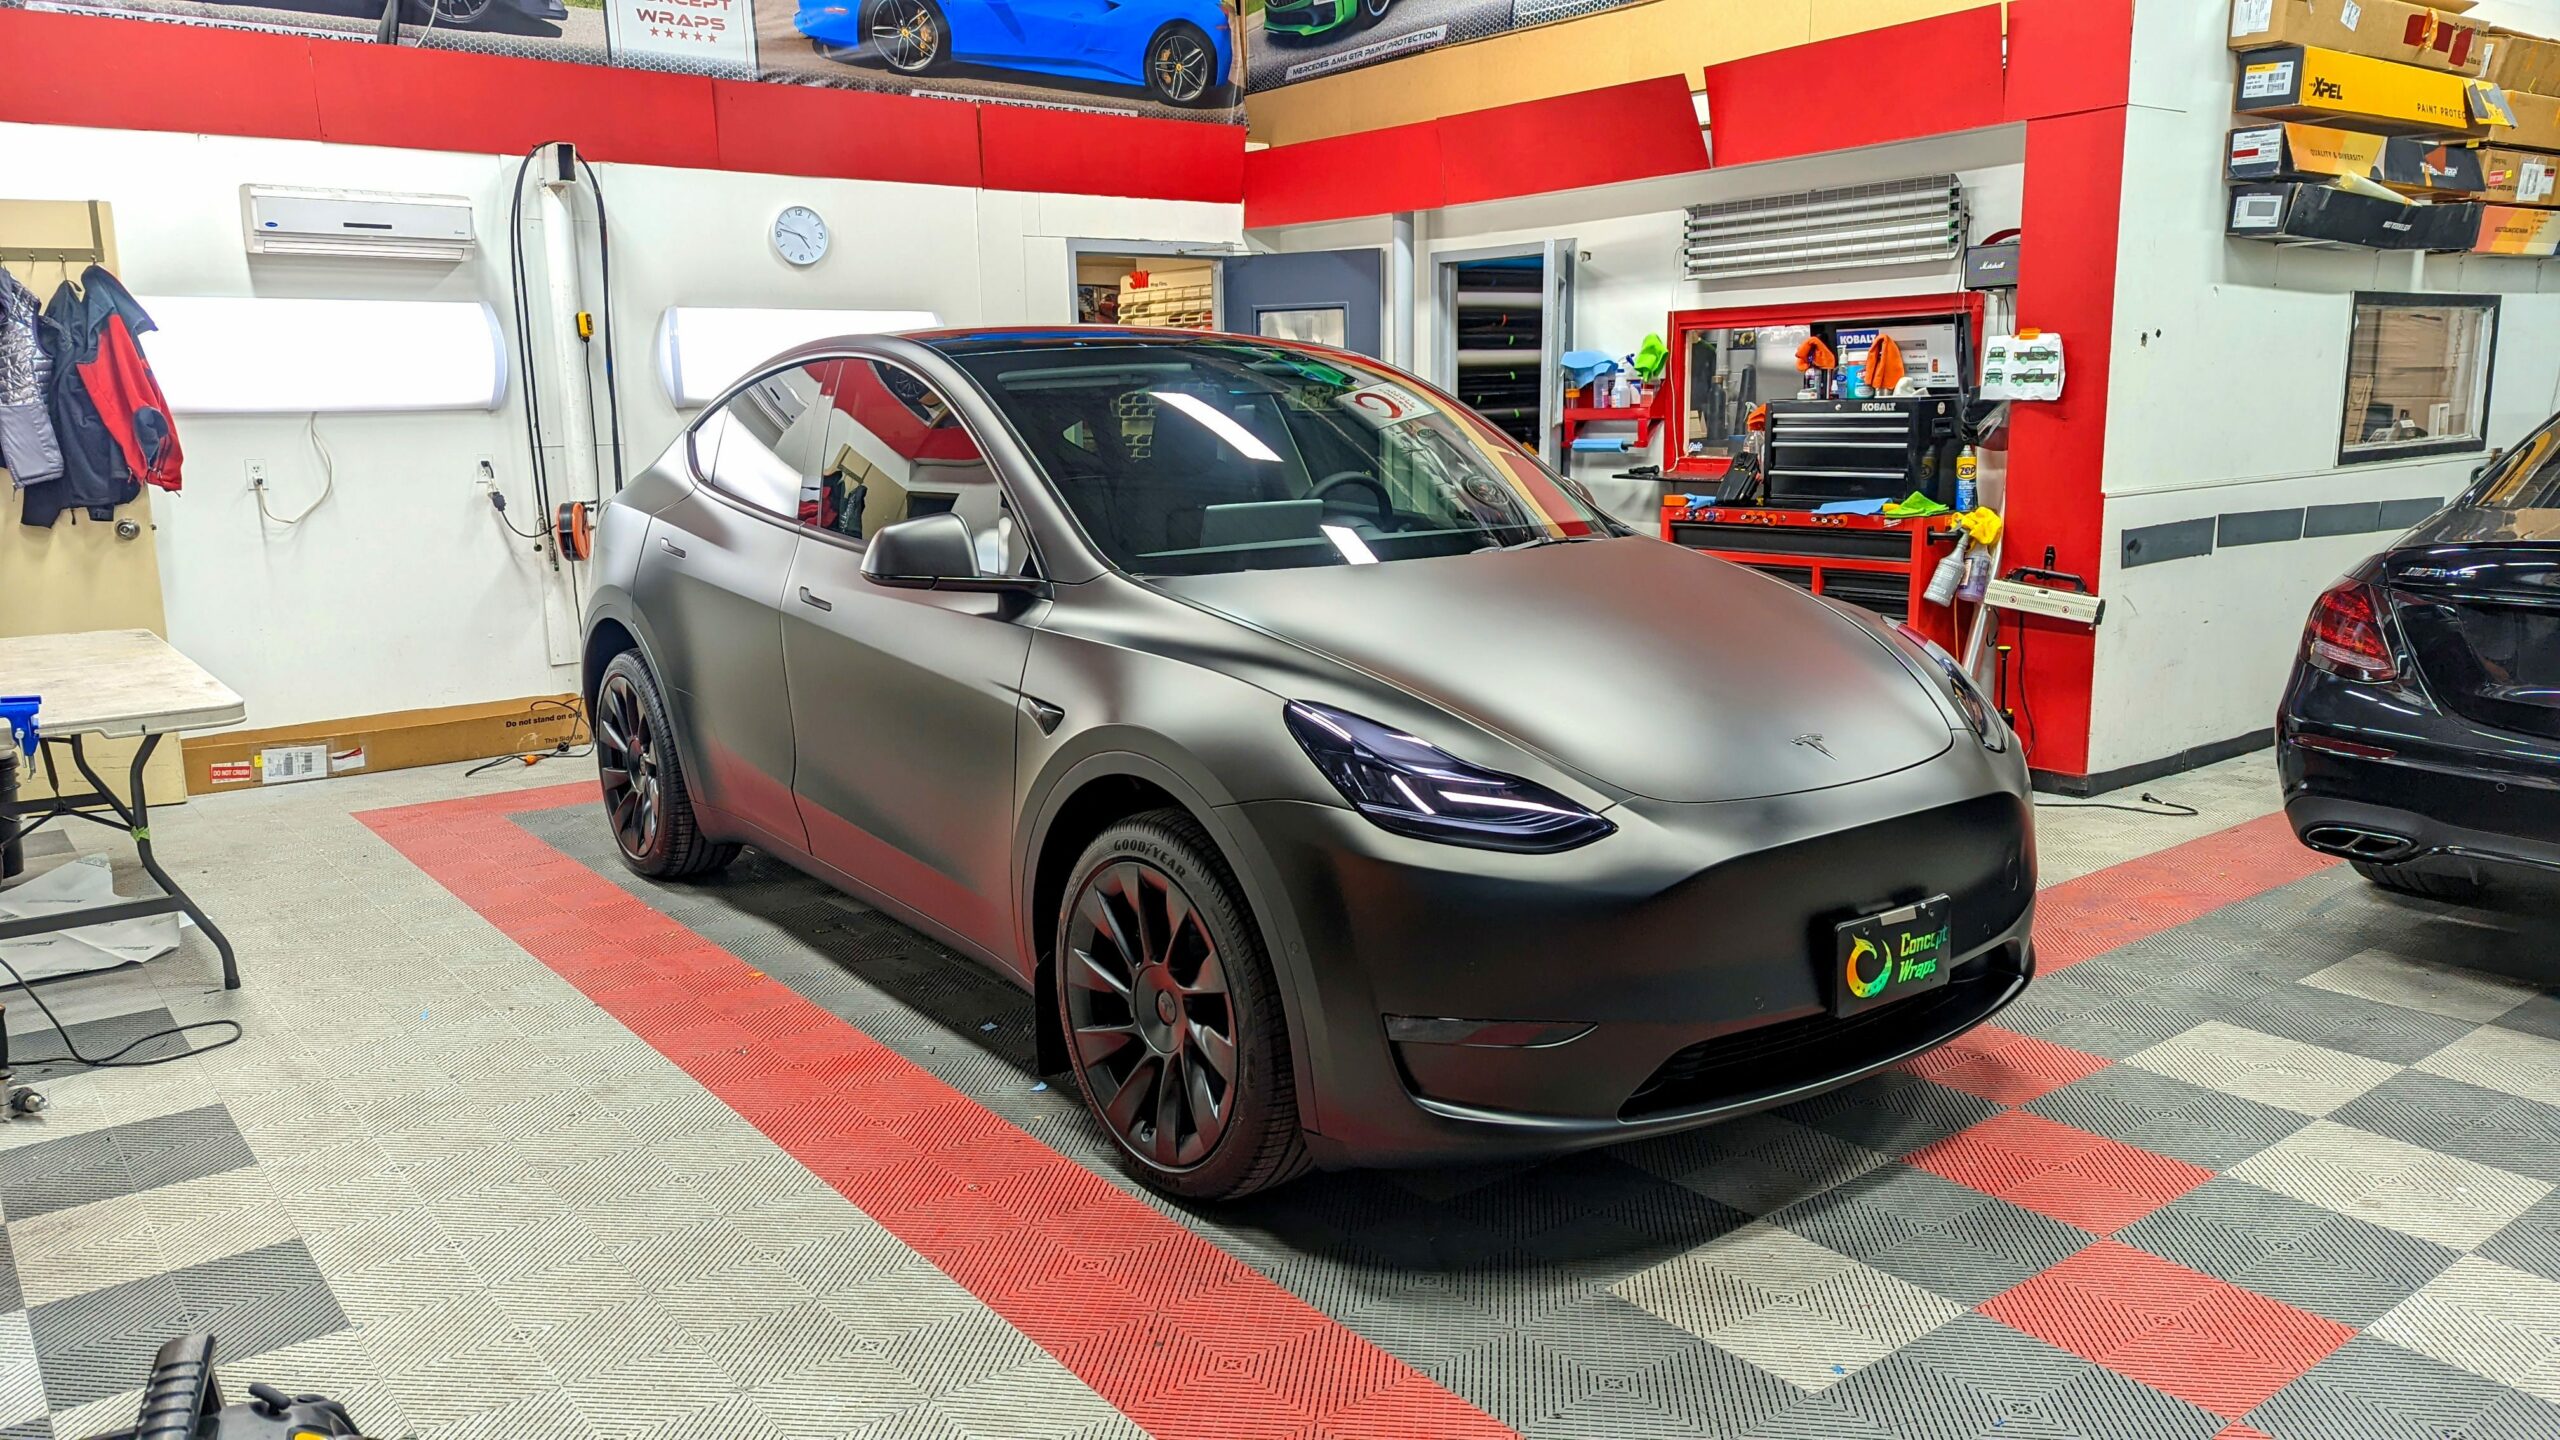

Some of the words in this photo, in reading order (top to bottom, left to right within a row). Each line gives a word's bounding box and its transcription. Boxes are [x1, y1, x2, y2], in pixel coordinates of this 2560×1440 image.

[636, 8, 726, 31] WRAPS
[1292, 59, 1329, 76] MERCEDES
[1331, 54, 1347, 66] AMG
[1365, 45, 1386, 57] PAINT
[1386, 30, 1438, 50] PROTECTION
[2311, 77, 2343, 100] XPEL
[2417, 102, 2437, 114] PAINT
[2310, 148, 2332, 159] QUALITY
[2333, 151, 2338, 159] &
[2338, 151, 2364, 161] DIVERSITY
[794, 209, 803, 217] 12
[818, 232, 824, 240] 3
[1129, 270, 1149, 290] 3M
[1839, 335, 1876, 345] KOBALT
[1861, 402, 1896, 411] KOBALT
[1959, 466, 1975, 476] zep
[505, 720, 517, 728] Do
[518, 718, 532, 727] not
[533, 714, 555, 725] stand
[556, 712, 567, 720] on
[544, 736, 558, 744] This
[573, 734, 584, 742] Up
[221, 769, 232, 777] NOT
[232, 768, 250, 777] CRUSH
[1114, 839, 1186, 879] GOODYEAR
[1900, 924, 1949, 957] Concept
[1898, 958, 1937, 984] Wraps
